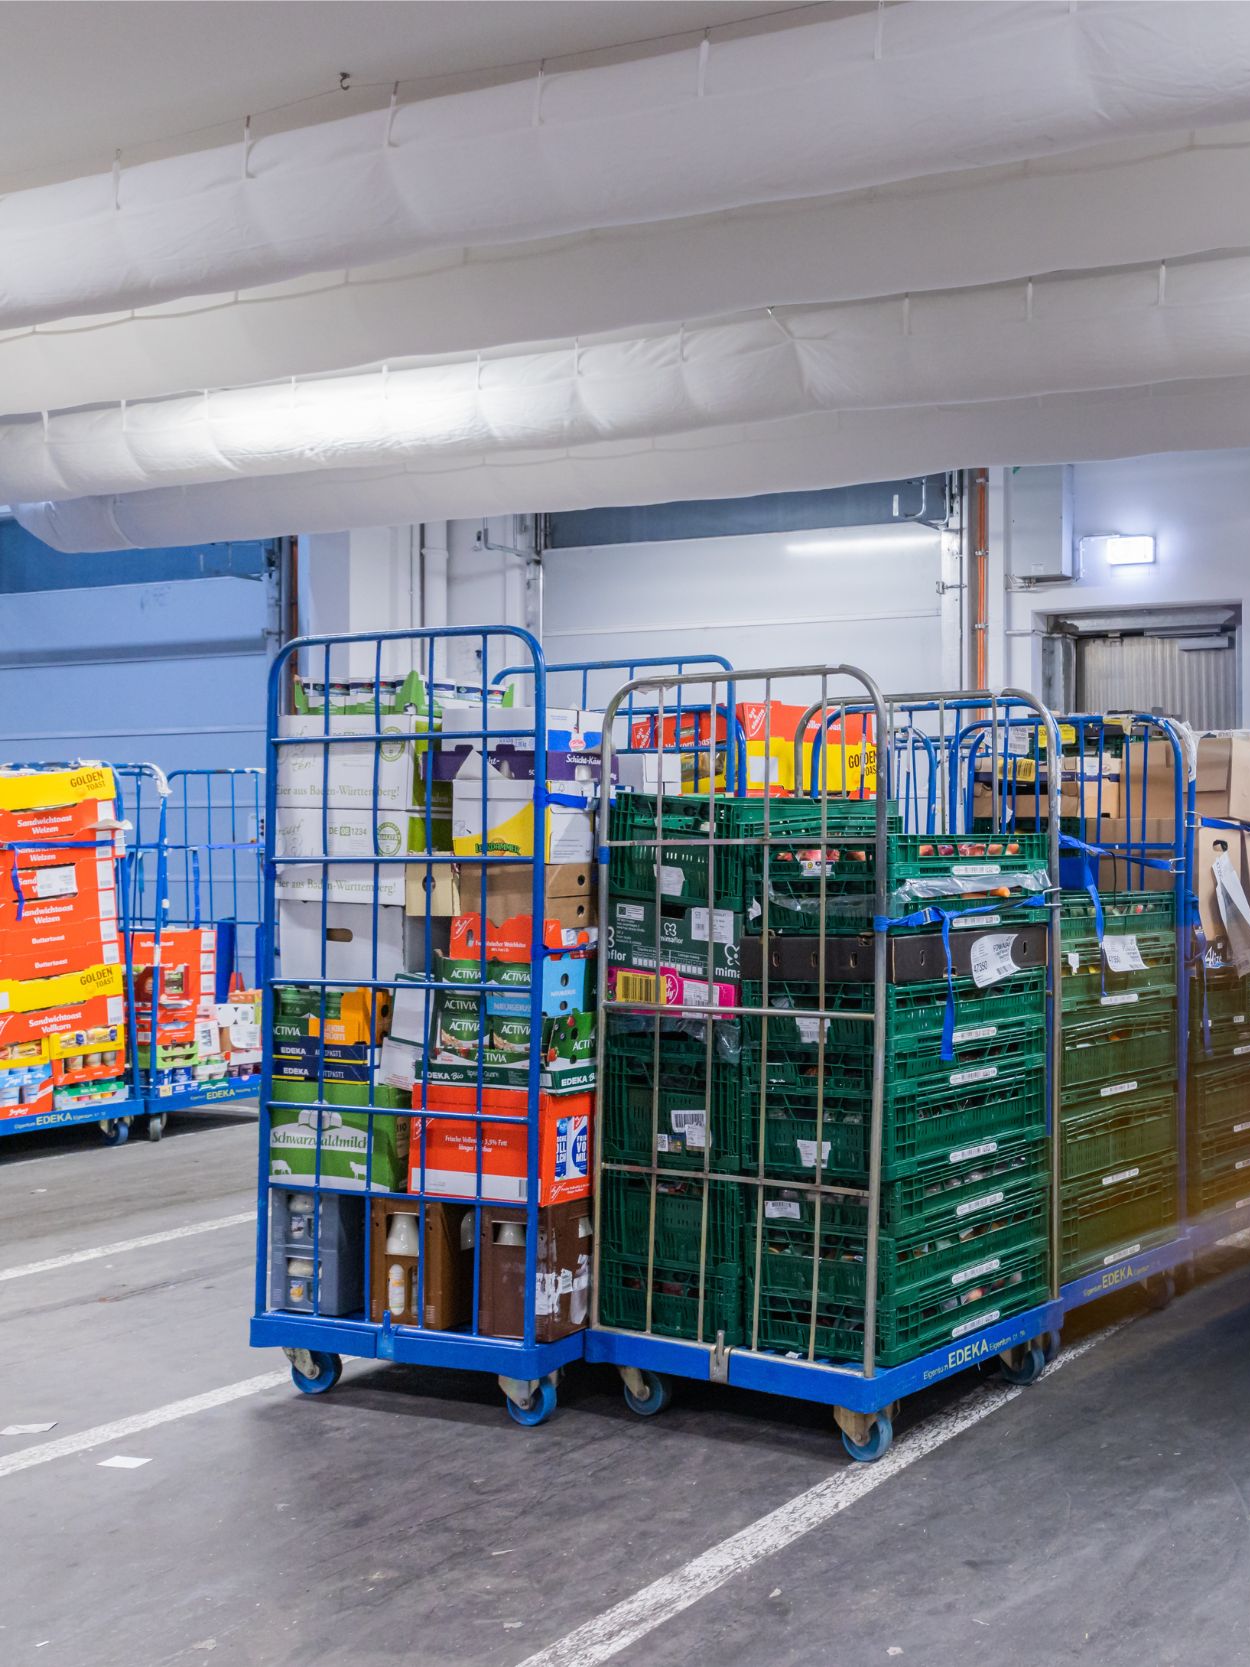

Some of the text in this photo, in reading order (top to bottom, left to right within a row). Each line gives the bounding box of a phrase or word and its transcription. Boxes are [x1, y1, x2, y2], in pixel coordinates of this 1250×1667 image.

[70, 770, 104, 788] GOLDEN
[86, 780, 106, 791] TOAST
[17, 815, 73, 827] Sandwichtoast
[32, 826, 59, 835] Weizen
[30, 854, 56, 862] Weizen
[34, 916, 61, 924] Weizen
[80, 967, 114, 986] GOLDEN
[96, 977, 114, 989] TOAST
[444, 1000, 477, 1010] ACTIVIA
[28, 1011, 82, 1028] Sandwichtoast
[41, 1022, 71, 1034] Vollkorn
[281, 1047, 306, 1055] EDEKA
[283, 1067, 309, 1076] EDEKA
[561, 1075, 588, 1087] EDEKA
[206, 1089, 236, 1100] EDEKA
[36, 1112, 73, 1126] EDEKA
[1102, 1264, 1133, 1289] EDEKA
[948, 1338, 989, 1369] EDEKA
